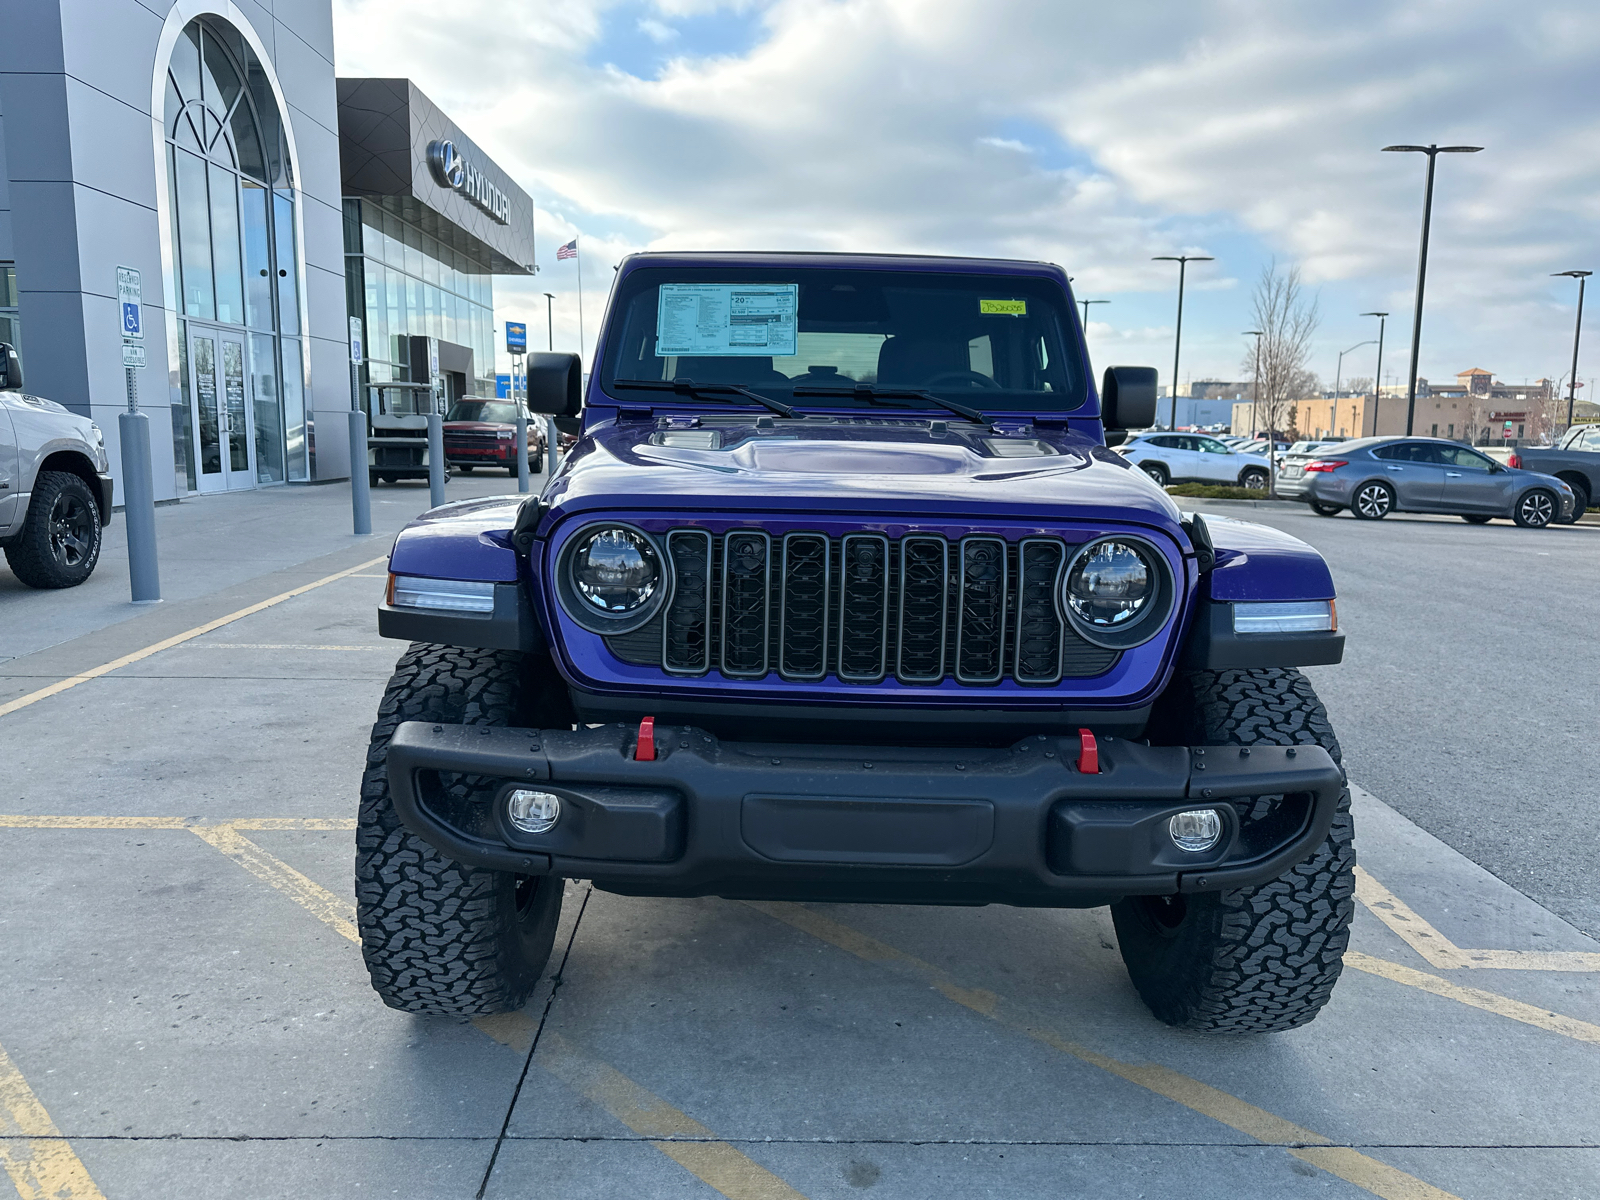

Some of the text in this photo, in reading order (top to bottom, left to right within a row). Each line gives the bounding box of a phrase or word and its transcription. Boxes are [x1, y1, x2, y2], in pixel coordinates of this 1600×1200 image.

[465, 161, 510, 225] HYUNDAI
[118, 272, 140, 286] RESERVED
[119, 284, 141, 298] PARKING
[123, 356, 145, 365] ACCESSIBLE
